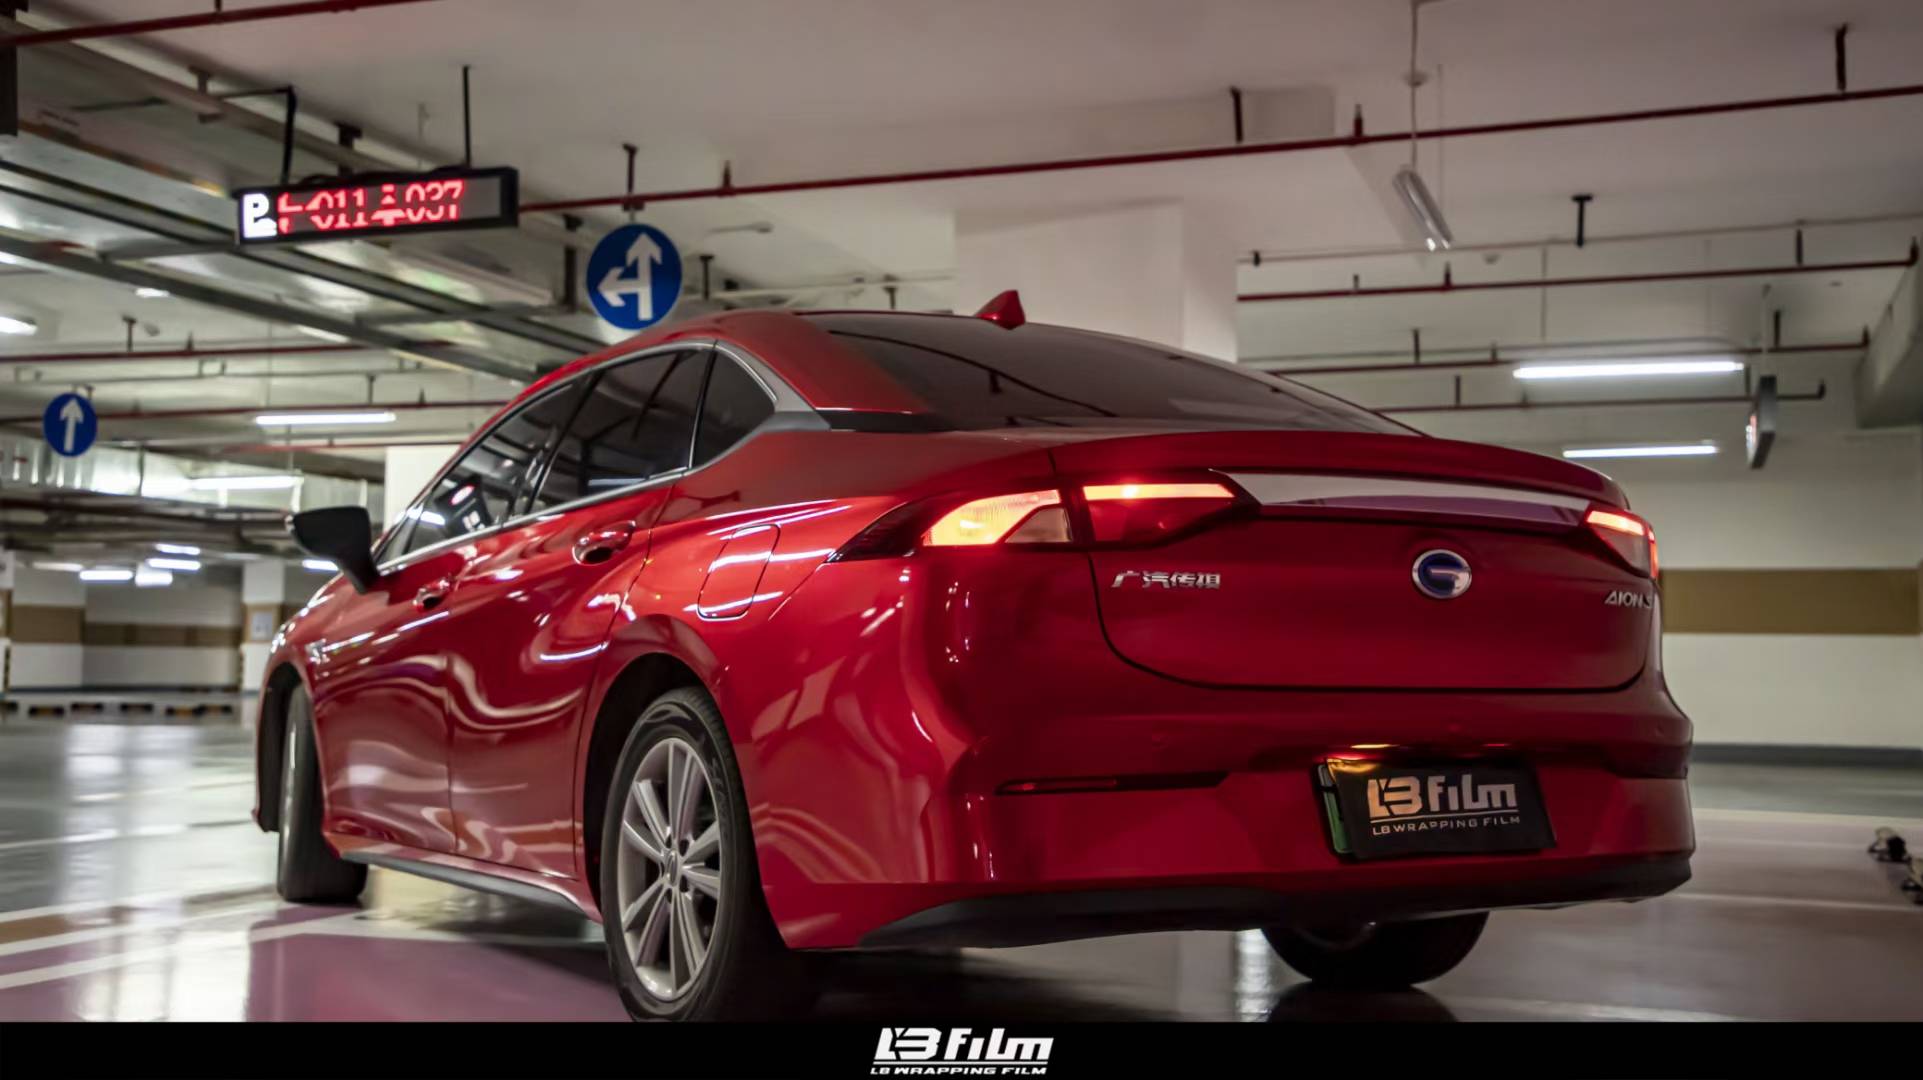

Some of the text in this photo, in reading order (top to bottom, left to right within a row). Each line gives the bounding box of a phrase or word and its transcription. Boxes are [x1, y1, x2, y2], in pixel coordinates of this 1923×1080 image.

[1604, 590, 1643, 607] AION
[1372, 816, 1521, 836] LB WRAPPING FILM
